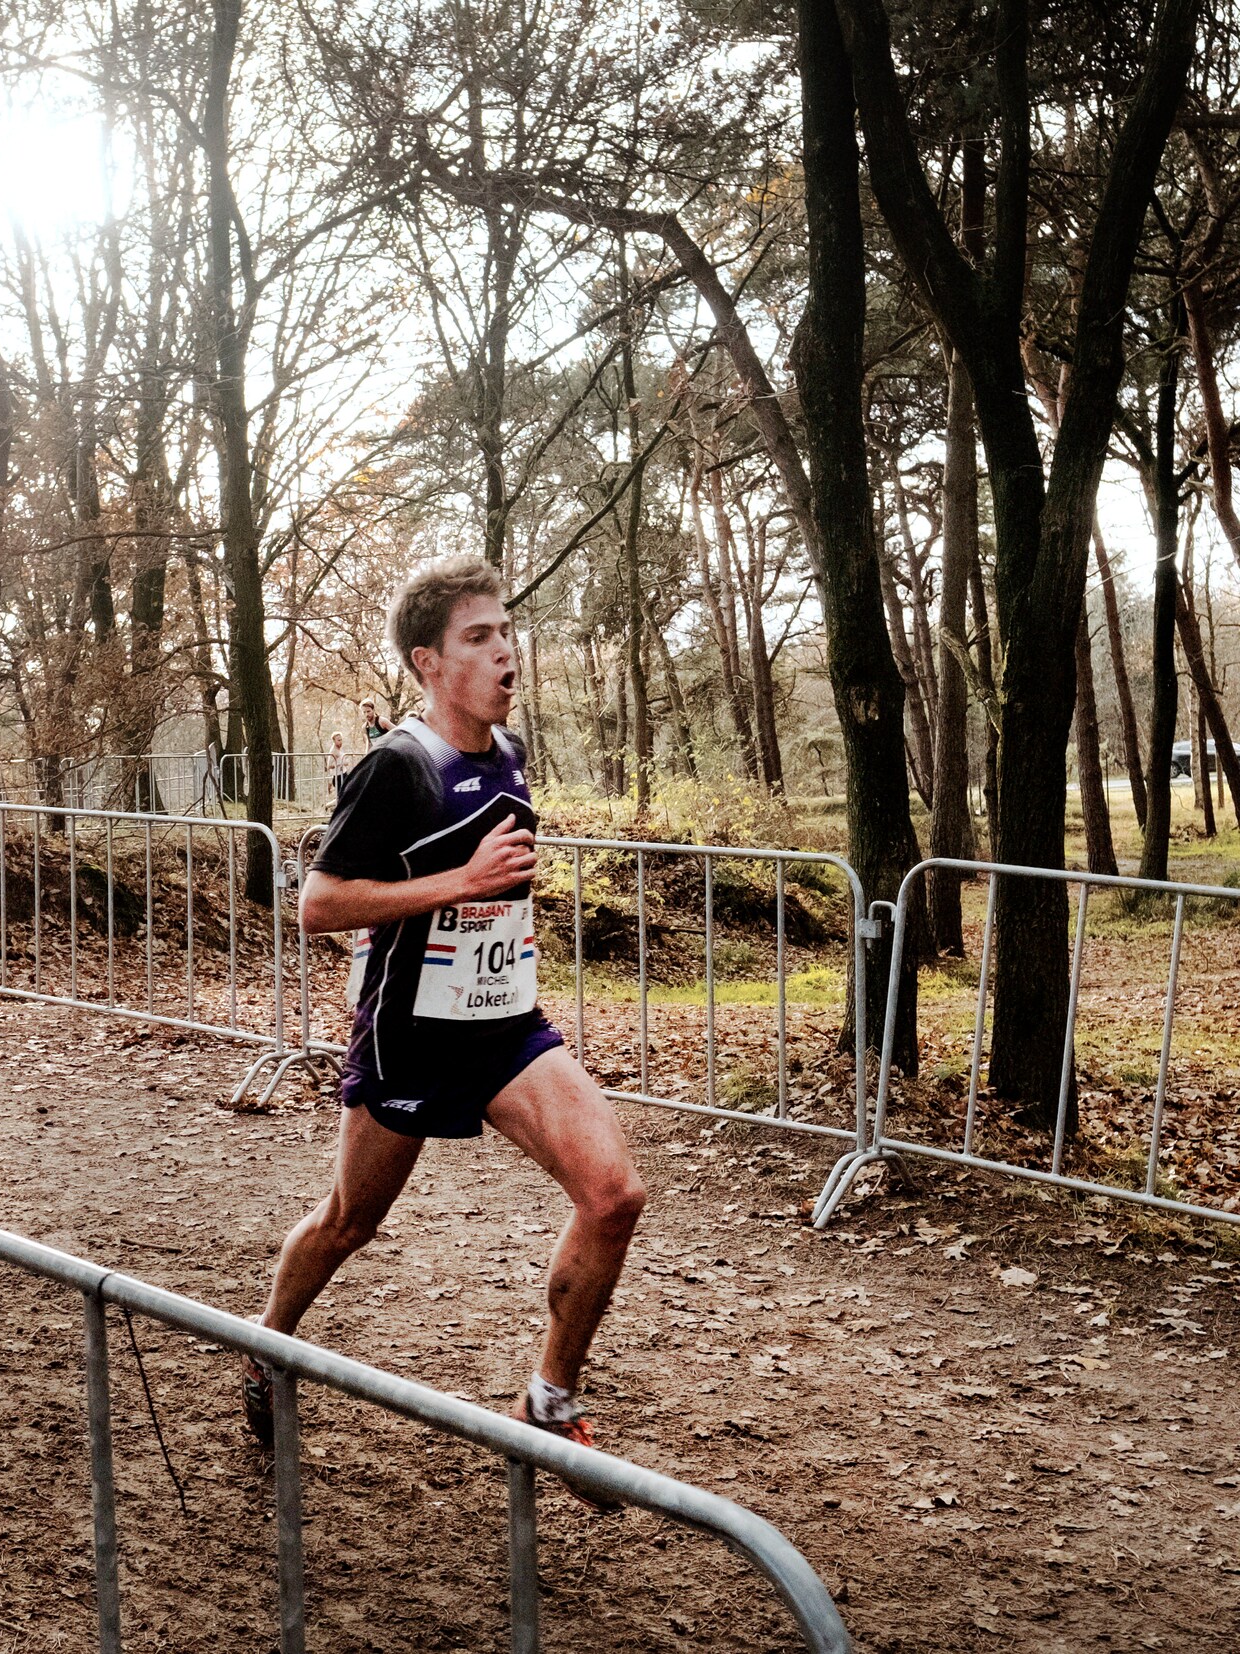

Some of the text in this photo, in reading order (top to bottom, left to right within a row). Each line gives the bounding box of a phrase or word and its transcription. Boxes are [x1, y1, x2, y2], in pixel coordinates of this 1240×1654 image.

[461, 904, 512, 919] BRABANT
[459, 919, 495, 933] SPORT
[473, 938, 516, 974] 104
[477, 976, 509, 986] MICHEL
